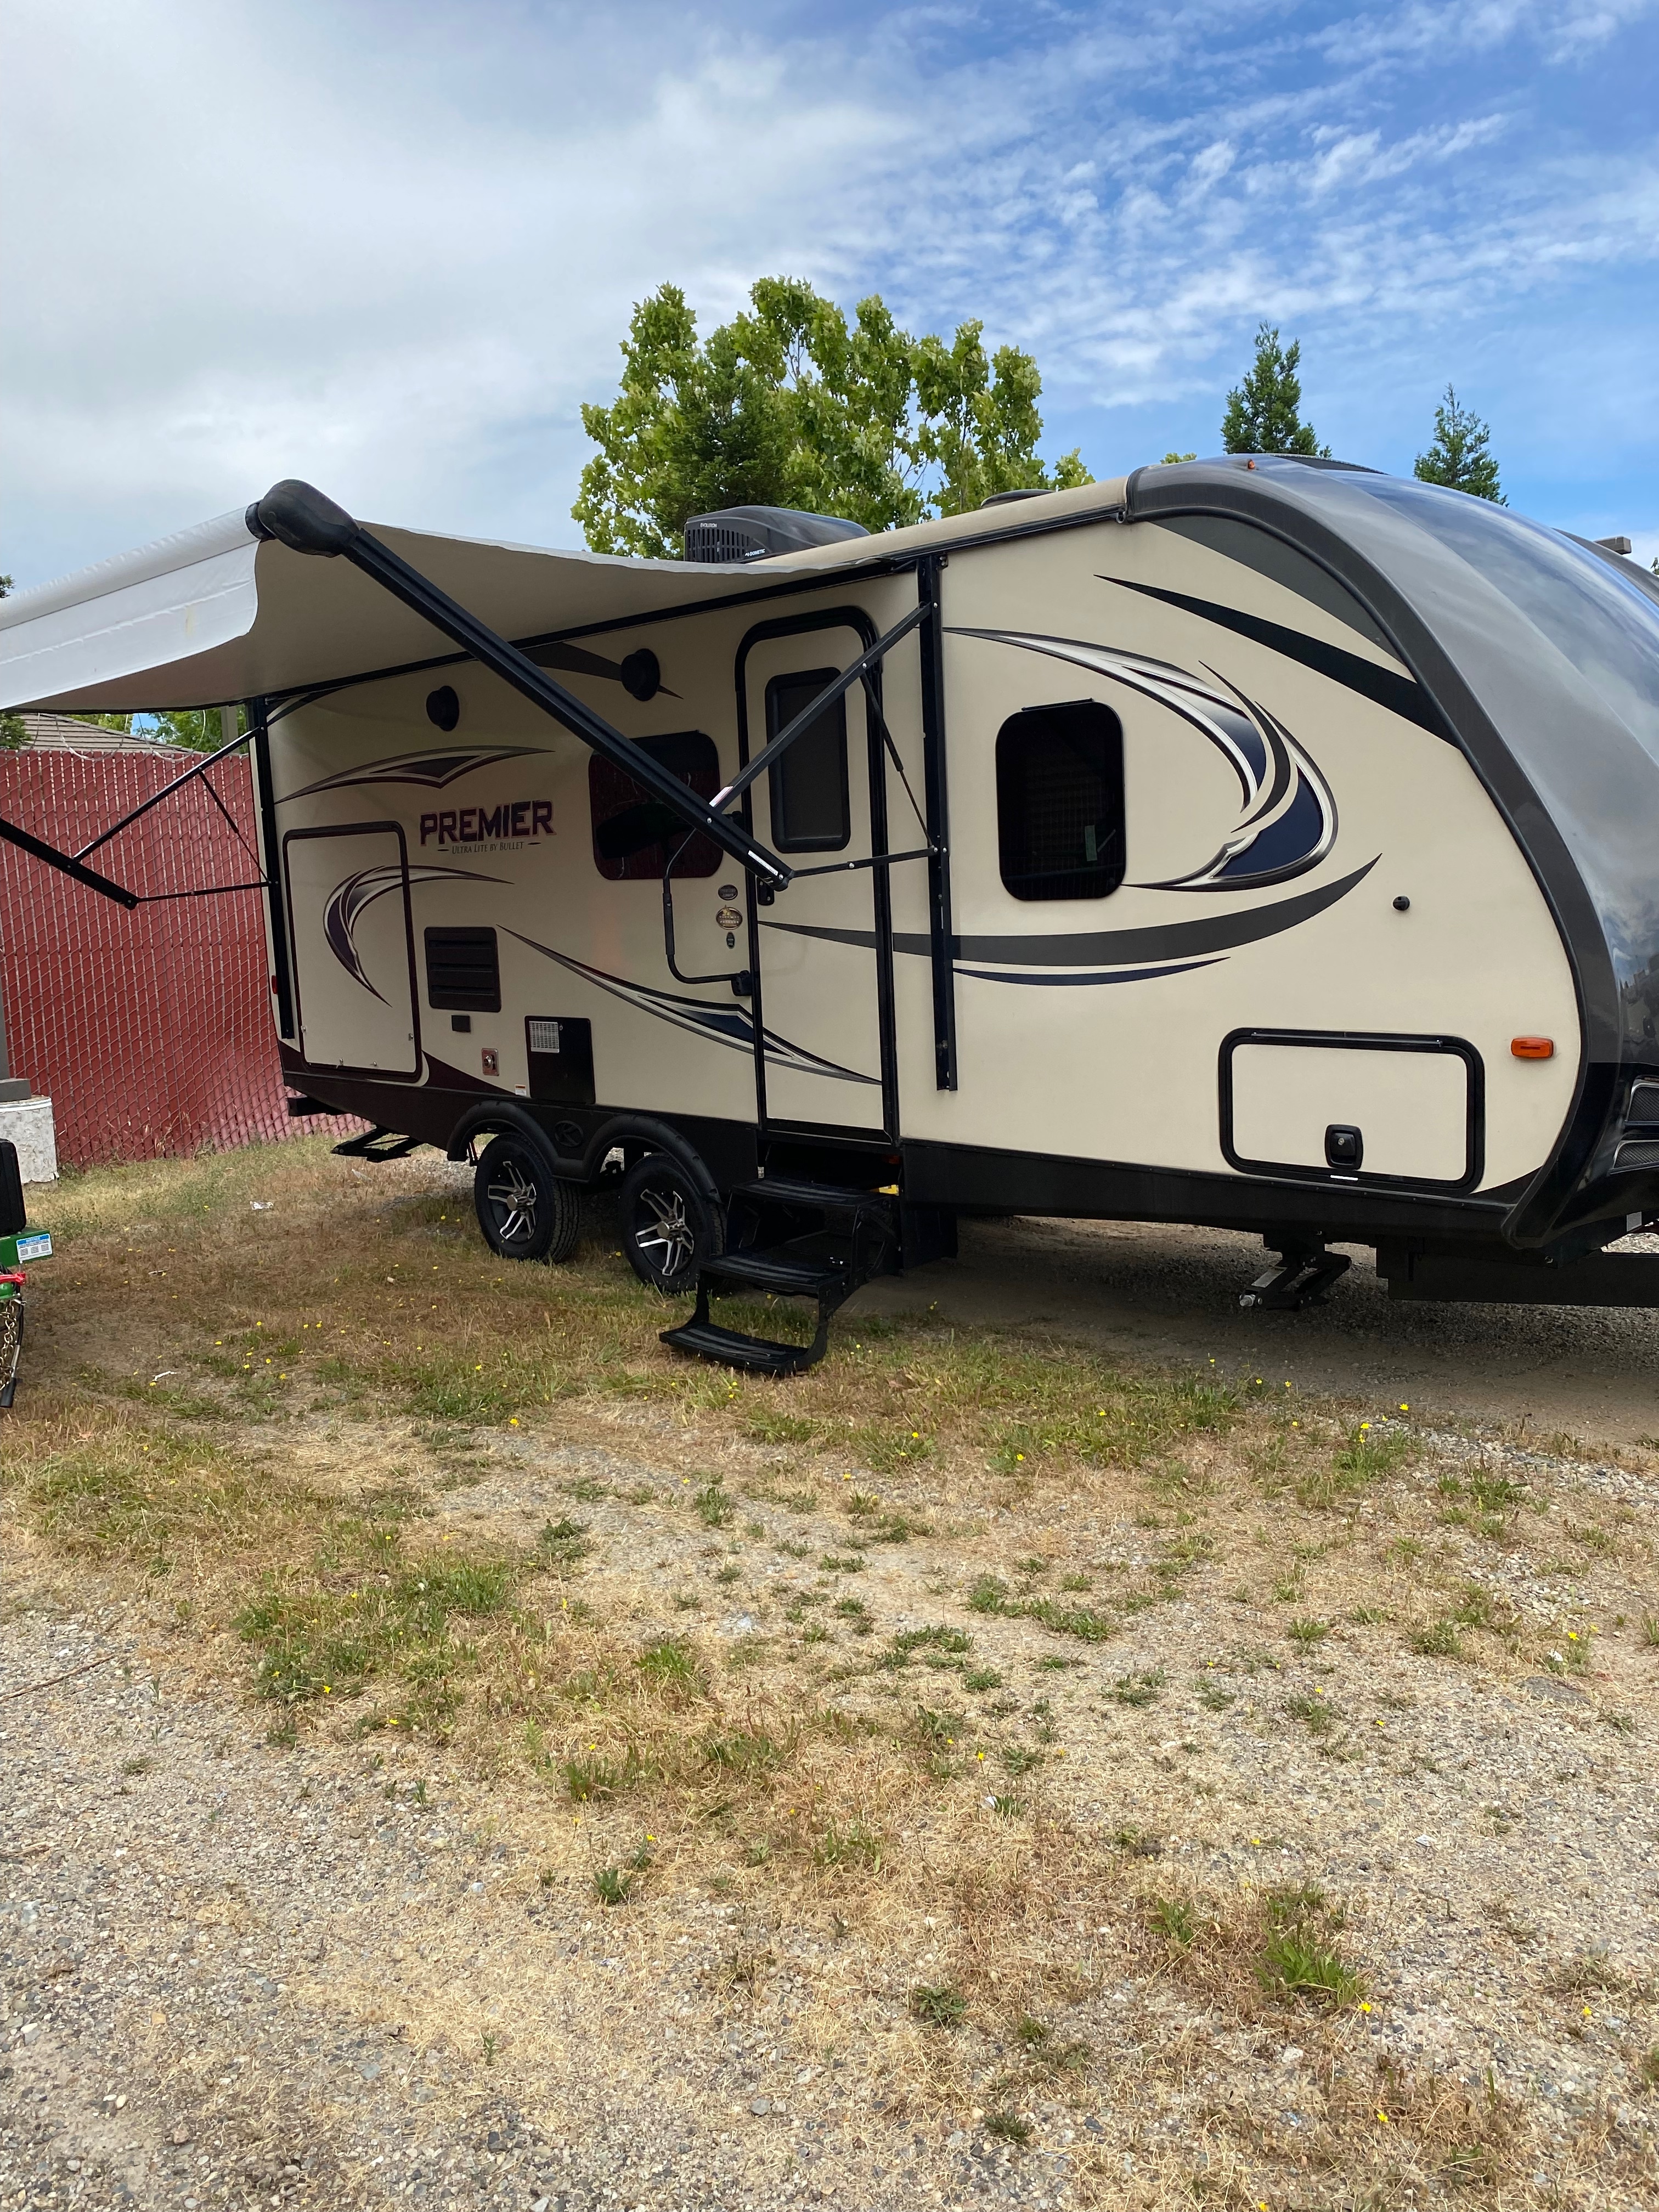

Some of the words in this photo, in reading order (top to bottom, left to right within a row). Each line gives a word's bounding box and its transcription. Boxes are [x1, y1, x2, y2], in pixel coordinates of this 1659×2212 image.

[749, 548, 766, 556] DOMETIC
[420, 799, 557, 846] PREMIER
[452, 845, 472, 854] ULTRA
[474, 844, 487, 852] LITE
[499, 842, 524, 851] BULLET
